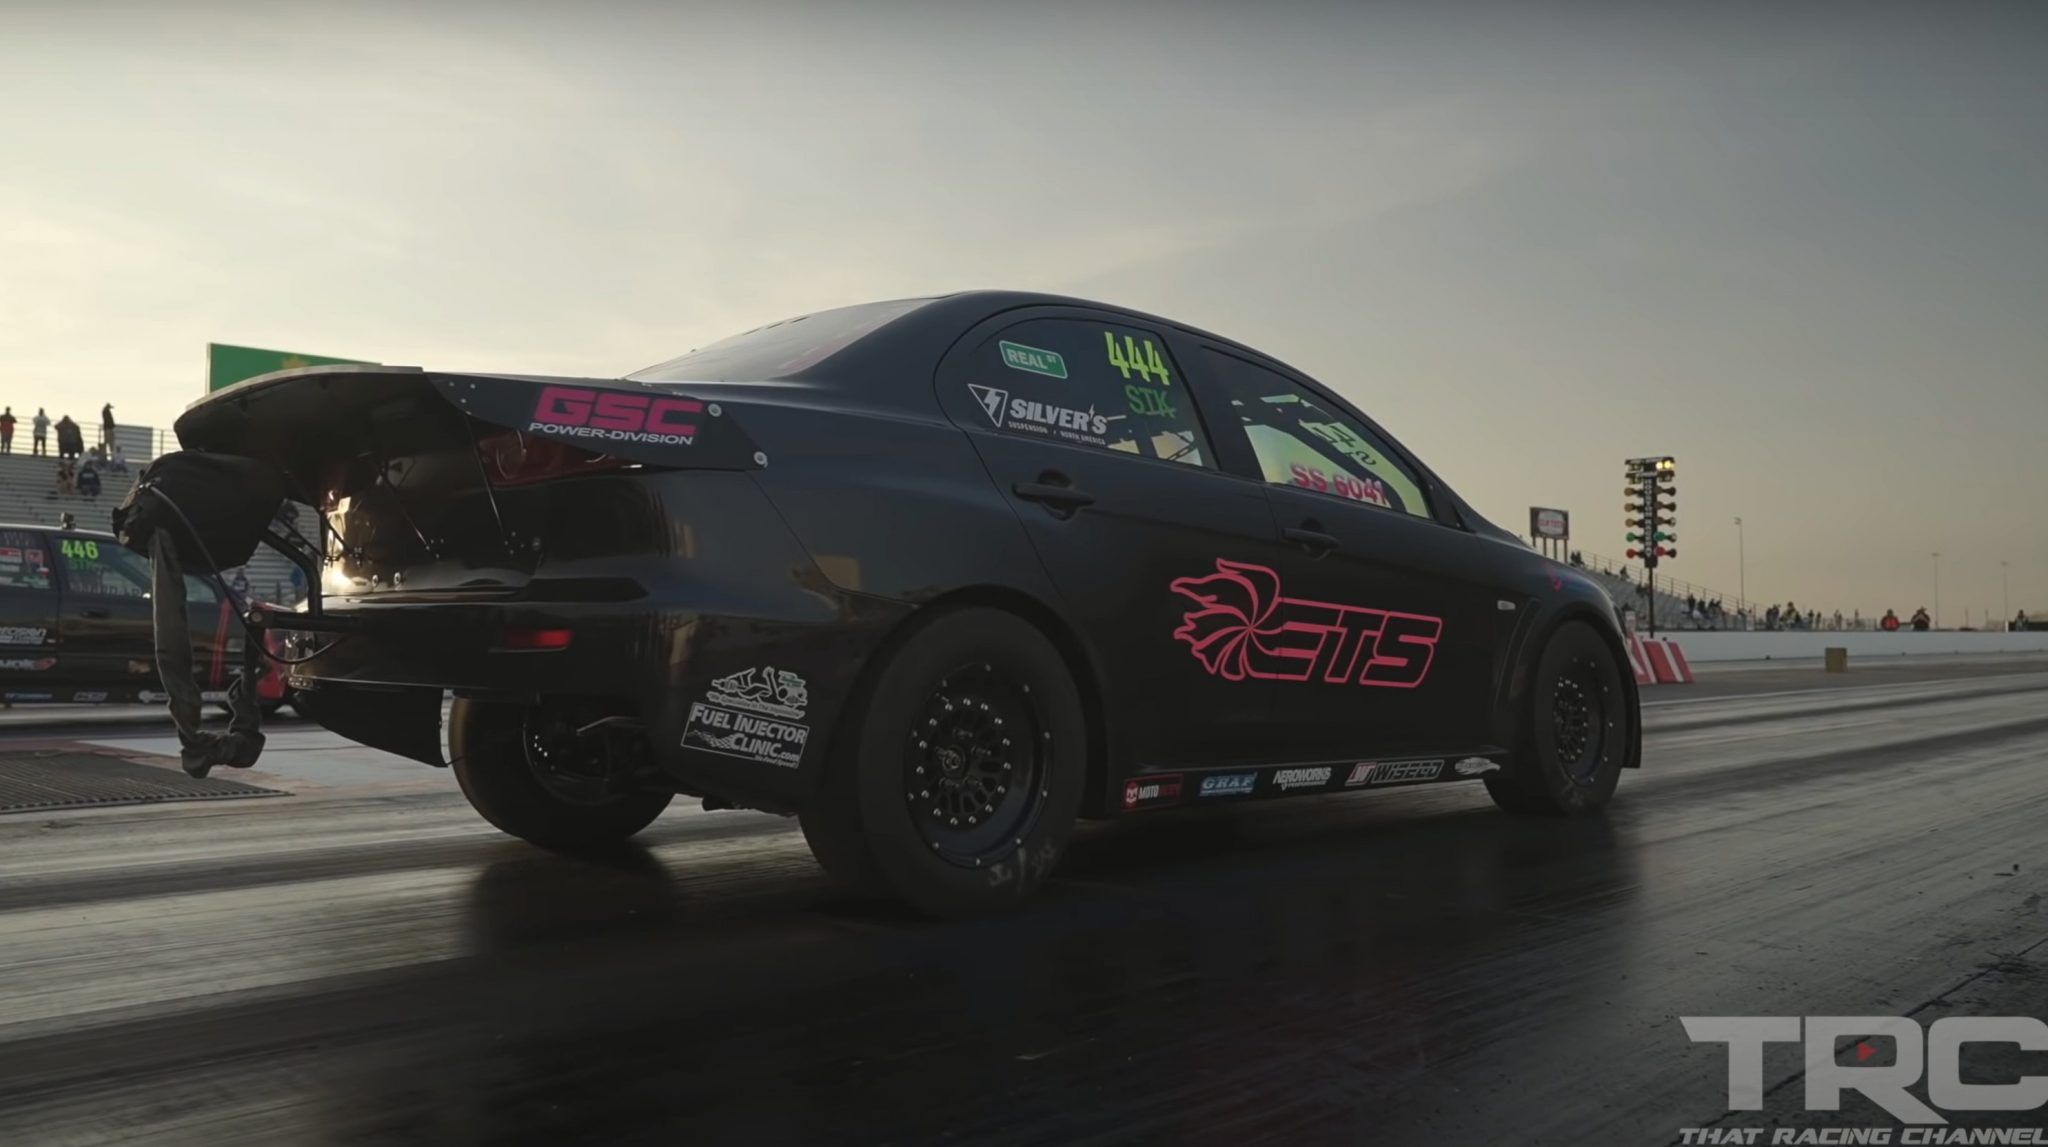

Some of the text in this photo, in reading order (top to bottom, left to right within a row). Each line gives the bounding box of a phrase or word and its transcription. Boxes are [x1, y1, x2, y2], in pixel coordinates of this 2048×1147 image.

[1006, 347, 1050, 370] REAL
[1104, 331, 1171, 386] 444
[534, 386, 705, 436] GSC
[1009, 396, 1108, 435] SILVER'S
[528, 421, 695, 446] POWER-DIVISION
[61, 539, 100, 560] 446
[689, 704, 807, 745] FUEL INJECTOR
[731, 732, 801, 763] CLINIC.com
[1201, 774, 1256, 790] GRAF
[1272, 766, 1334, 785] AEROWORKS
